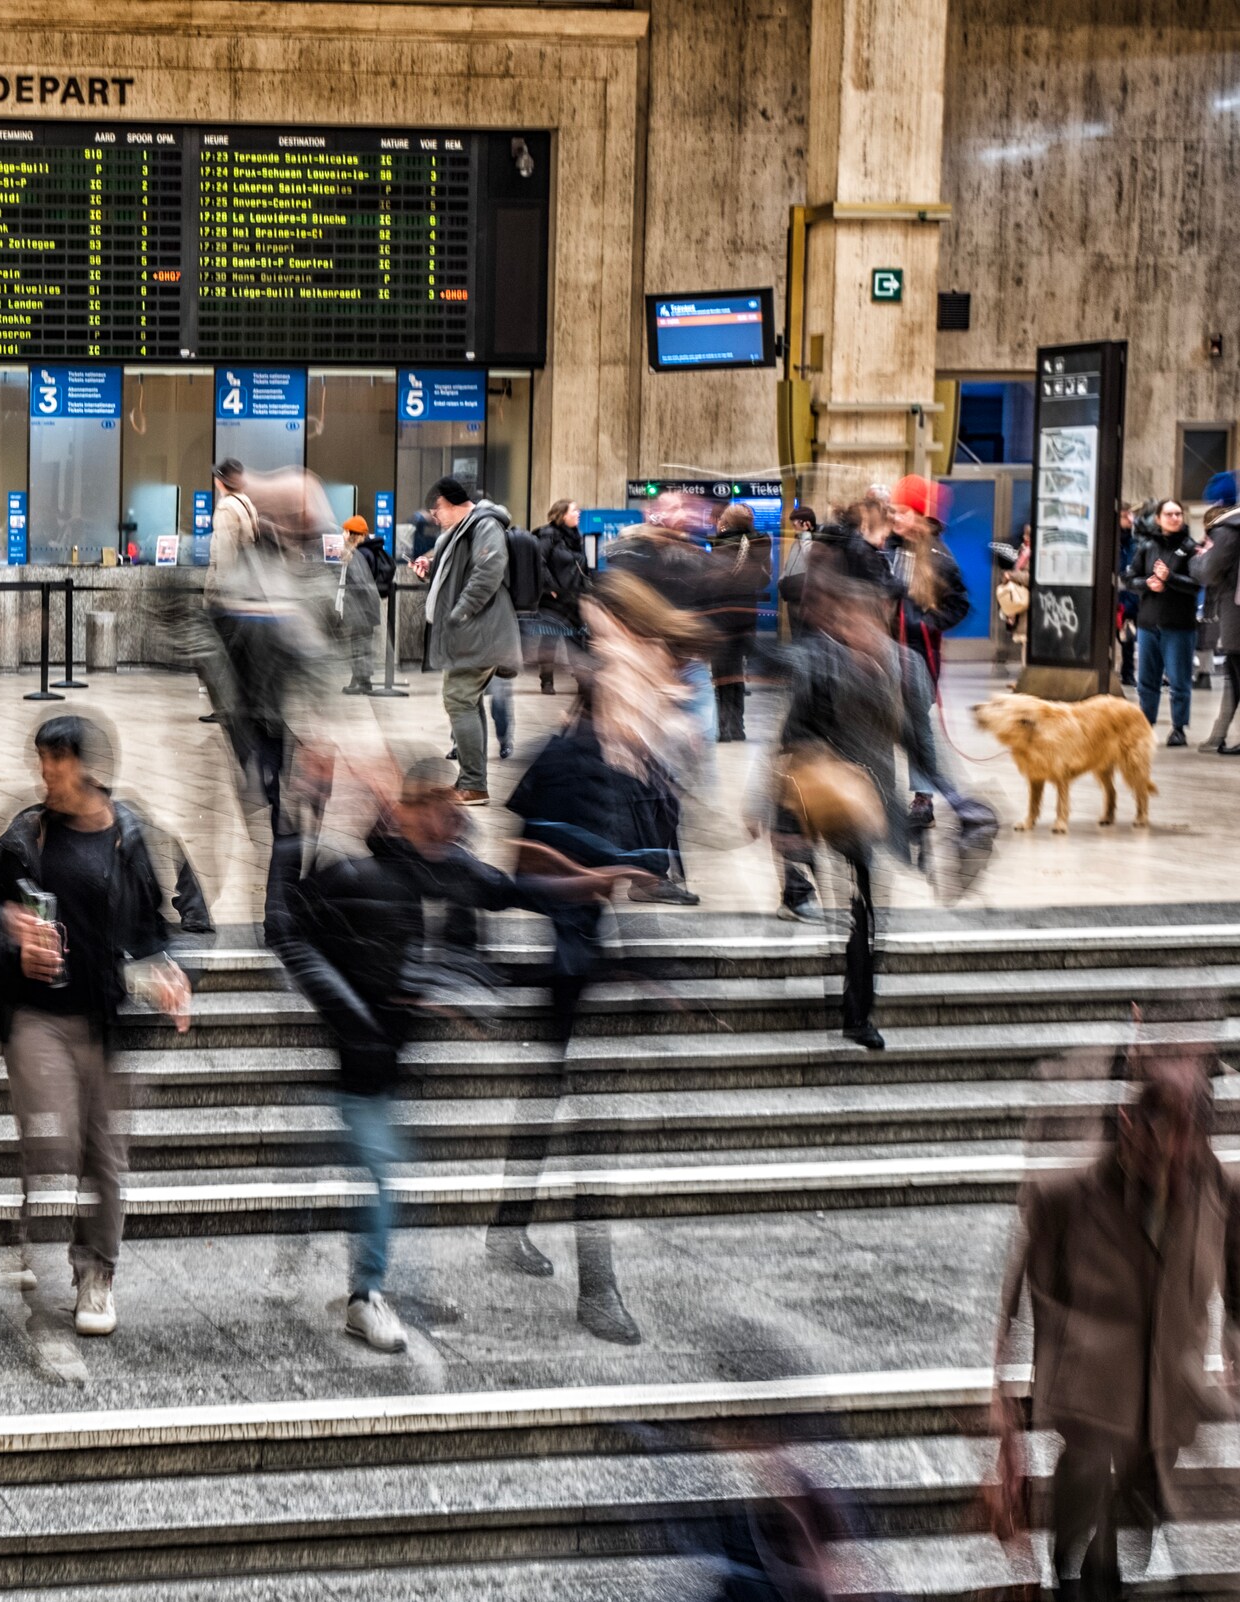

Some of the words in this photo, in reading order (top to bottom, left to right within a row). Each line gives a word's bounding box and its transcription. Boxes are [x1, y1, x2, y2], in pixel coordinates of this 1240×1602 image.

[95, 131, 116, 143] AARD
[127, 132, 153, 144] SPOOR
[156, 133, 176, 145] OPM.
[204, 135, 229, 145] HEURE
[278, 136, 325, 148] DESTINATION
[381, 138, 410, 149] NATURE
[420, 138, 438, 150] VOIE
[445, 139, 463, 150] REM.
[90, 179, 102, 190] IC
[90, 195, 101, 205] IC
[90, 210, 101, 220] IC
[90, 225, 101, 235] IC
[39, 386, 58, 413] 3
[223, 388, 243, 414] 4
[406, 390, 424, 417] 5
